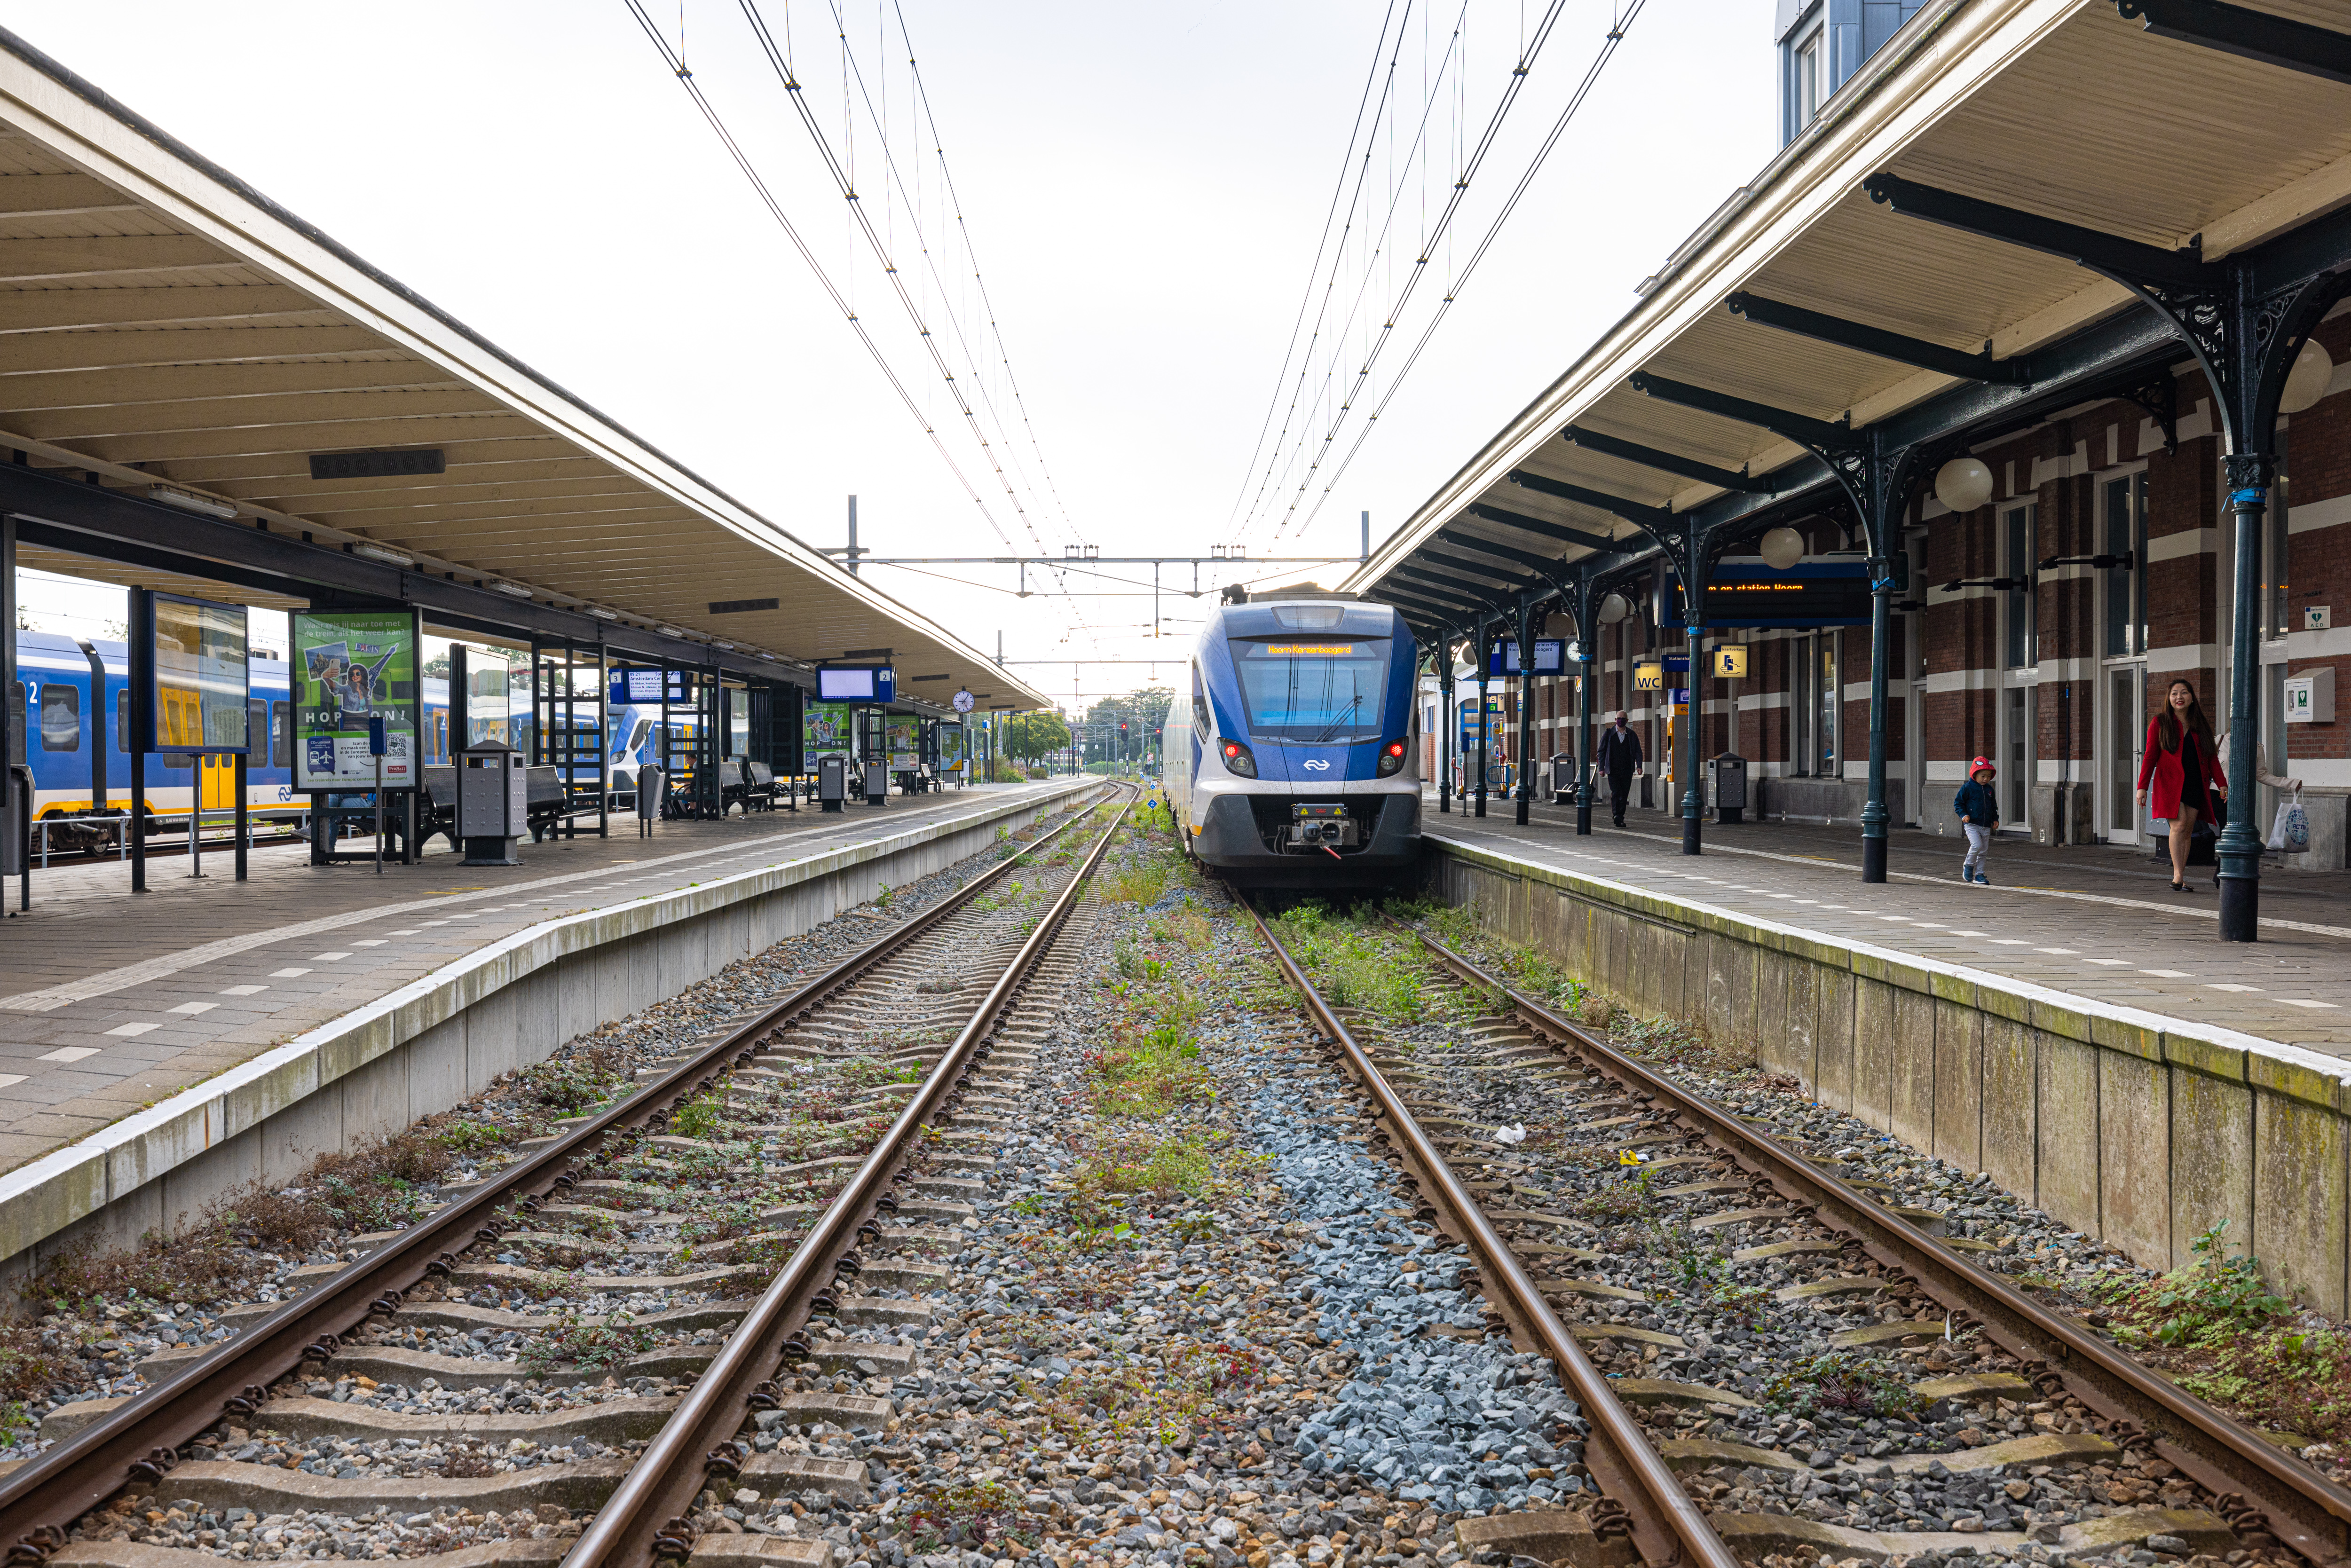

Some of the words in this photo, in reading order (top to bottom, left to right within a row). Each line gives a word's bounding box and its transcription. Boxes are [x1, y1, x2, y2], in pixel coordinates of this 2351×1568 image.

[355, 643, 379, 654] PARIS
[1293, 645, 1350, 654] Kersenboogerd
[1638, 678, 1660, 688] WC
[30, 681, 38, 703] 2
[306, 712, 342, 723] HOP
[371, 710, 405, 721] ON!
[442, 712, 445, 725] 2
[519, 718, 521, 731] 2
